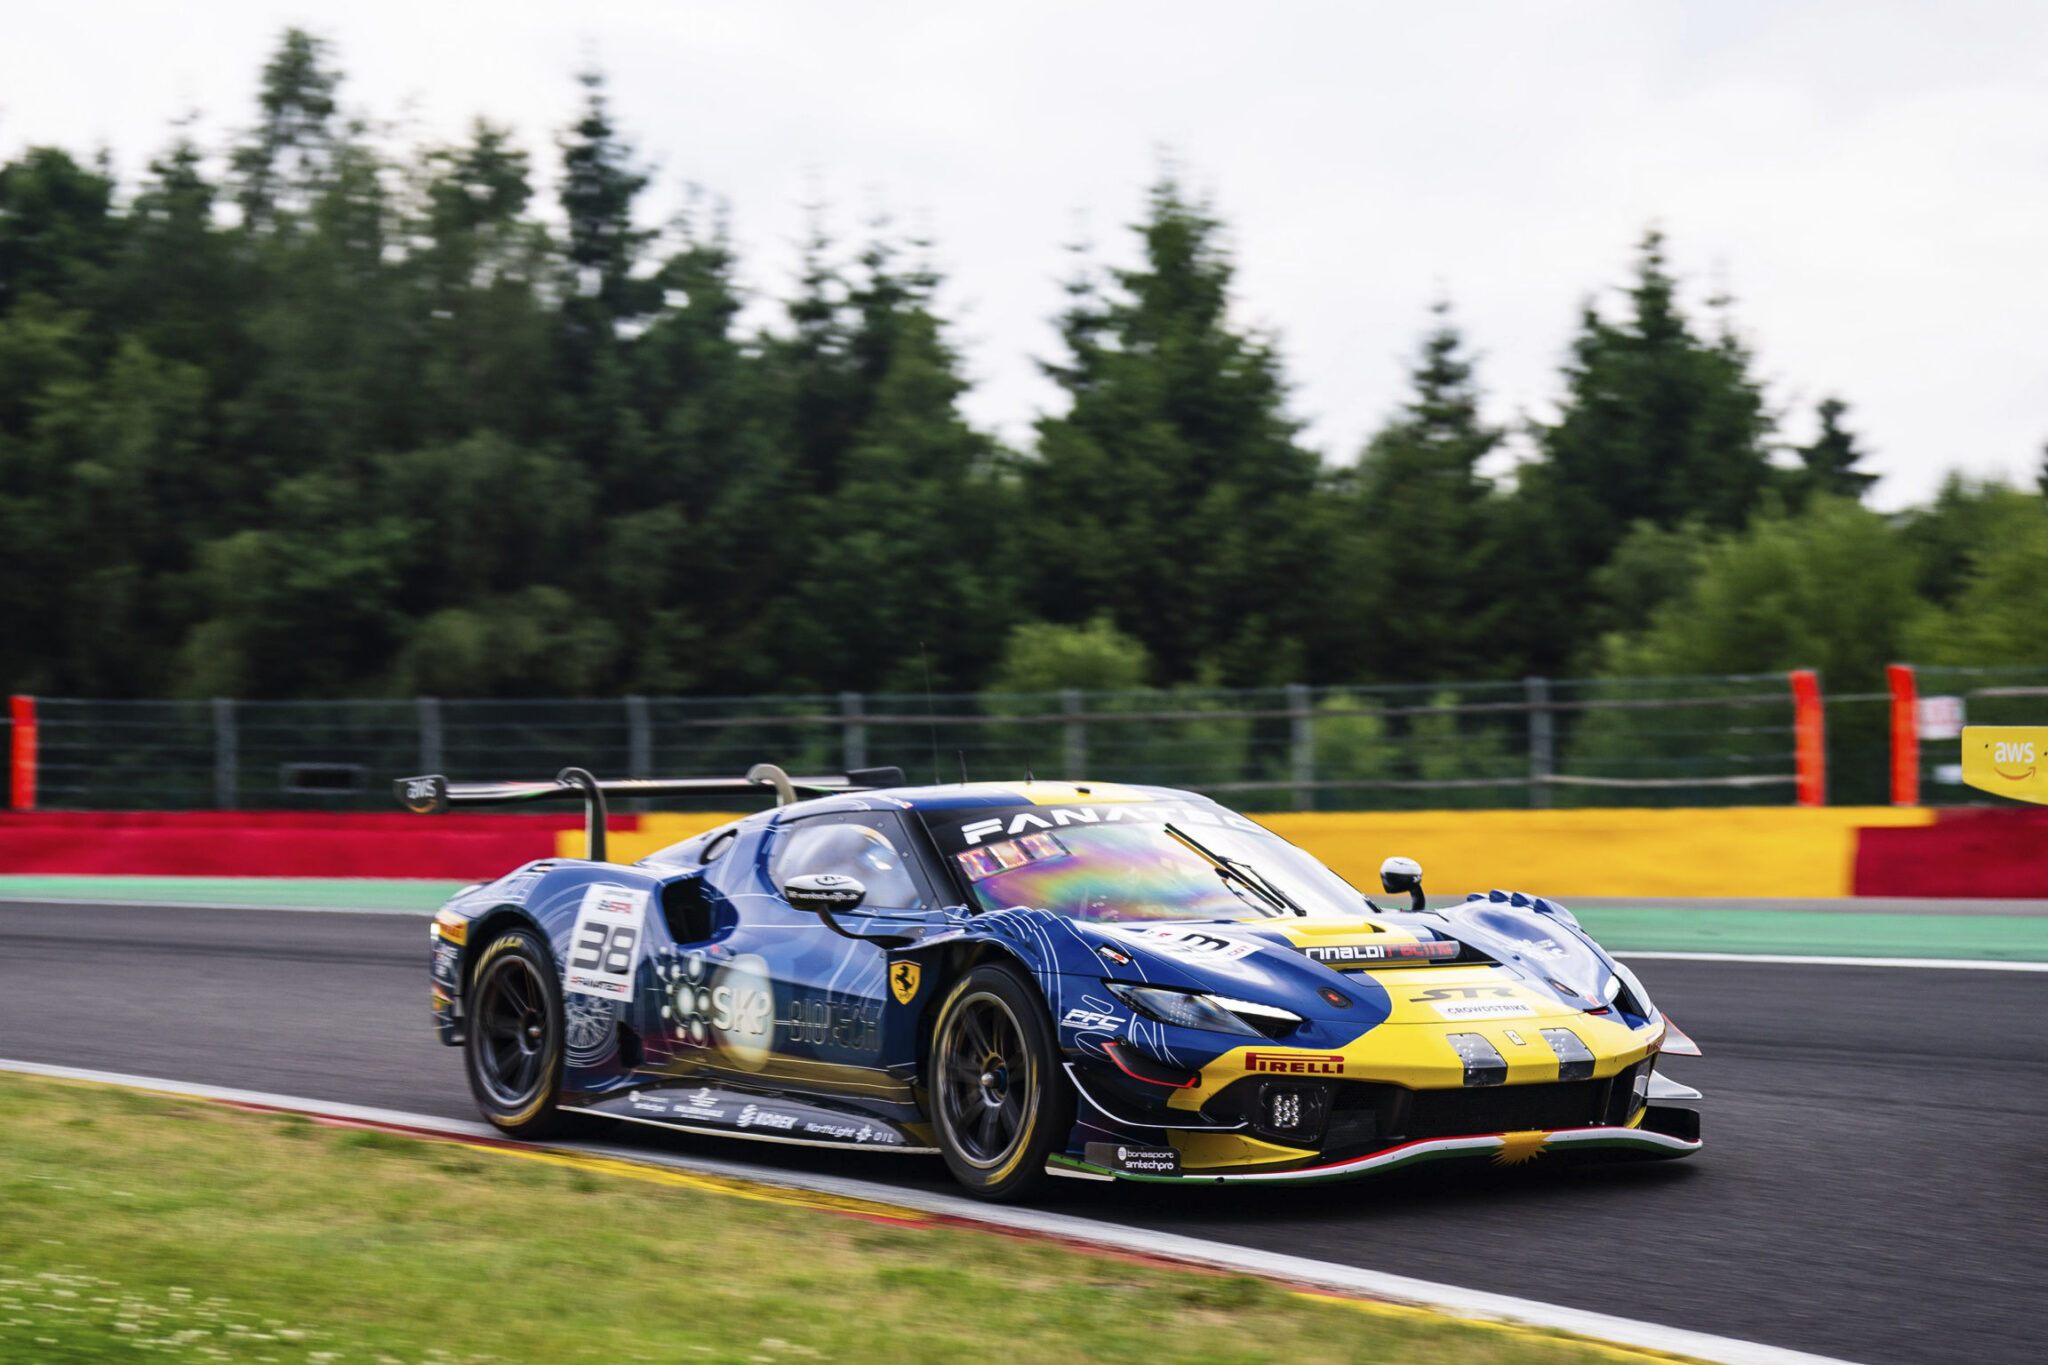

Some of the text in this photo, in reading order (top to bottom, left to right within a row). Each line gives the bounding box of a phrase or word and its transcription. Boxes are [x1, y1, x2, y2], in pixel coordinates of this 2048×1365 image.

[1994, 741, 2035, 763] aws
[572, 921, 637, 976] 38
[1447, 1003, 1529, 1015] CROWDSTRIKE
[1245, 1052, 1345, 1074] PIRELLI
